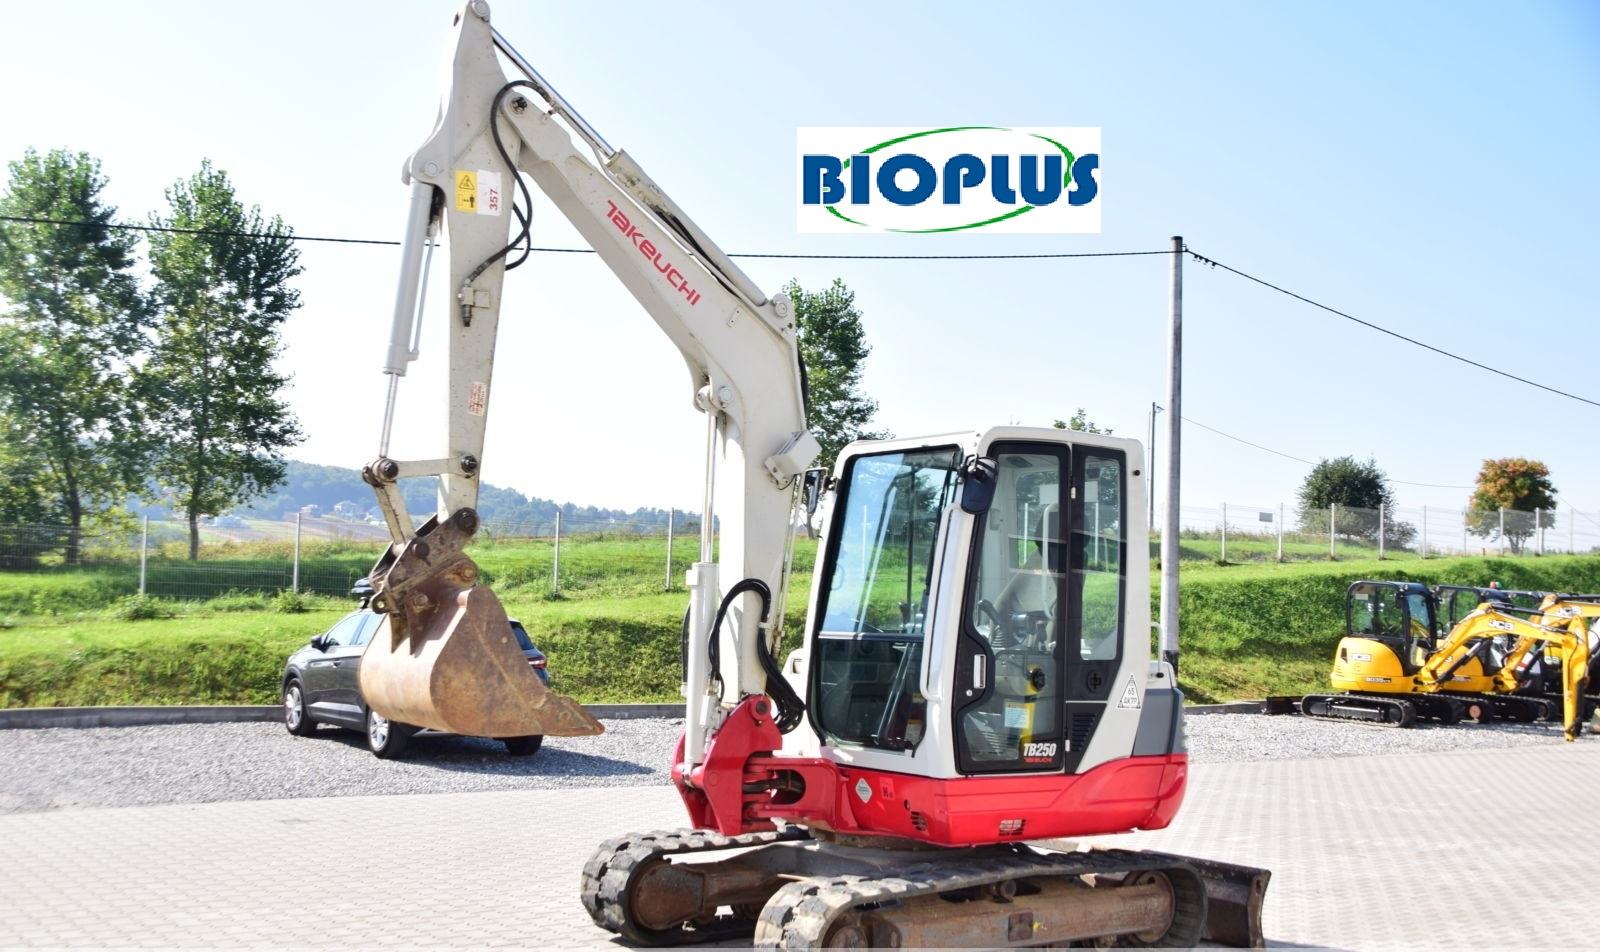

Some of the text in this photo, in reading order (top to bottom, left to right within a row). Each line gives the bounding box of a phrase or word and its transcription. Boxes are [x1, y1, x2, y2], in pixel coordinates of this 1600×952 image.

[489, 188, 498, 210] 357
[607, 200, 701, 306] TAKEUCHI
[1023, 743, 1057, 757] TB250
